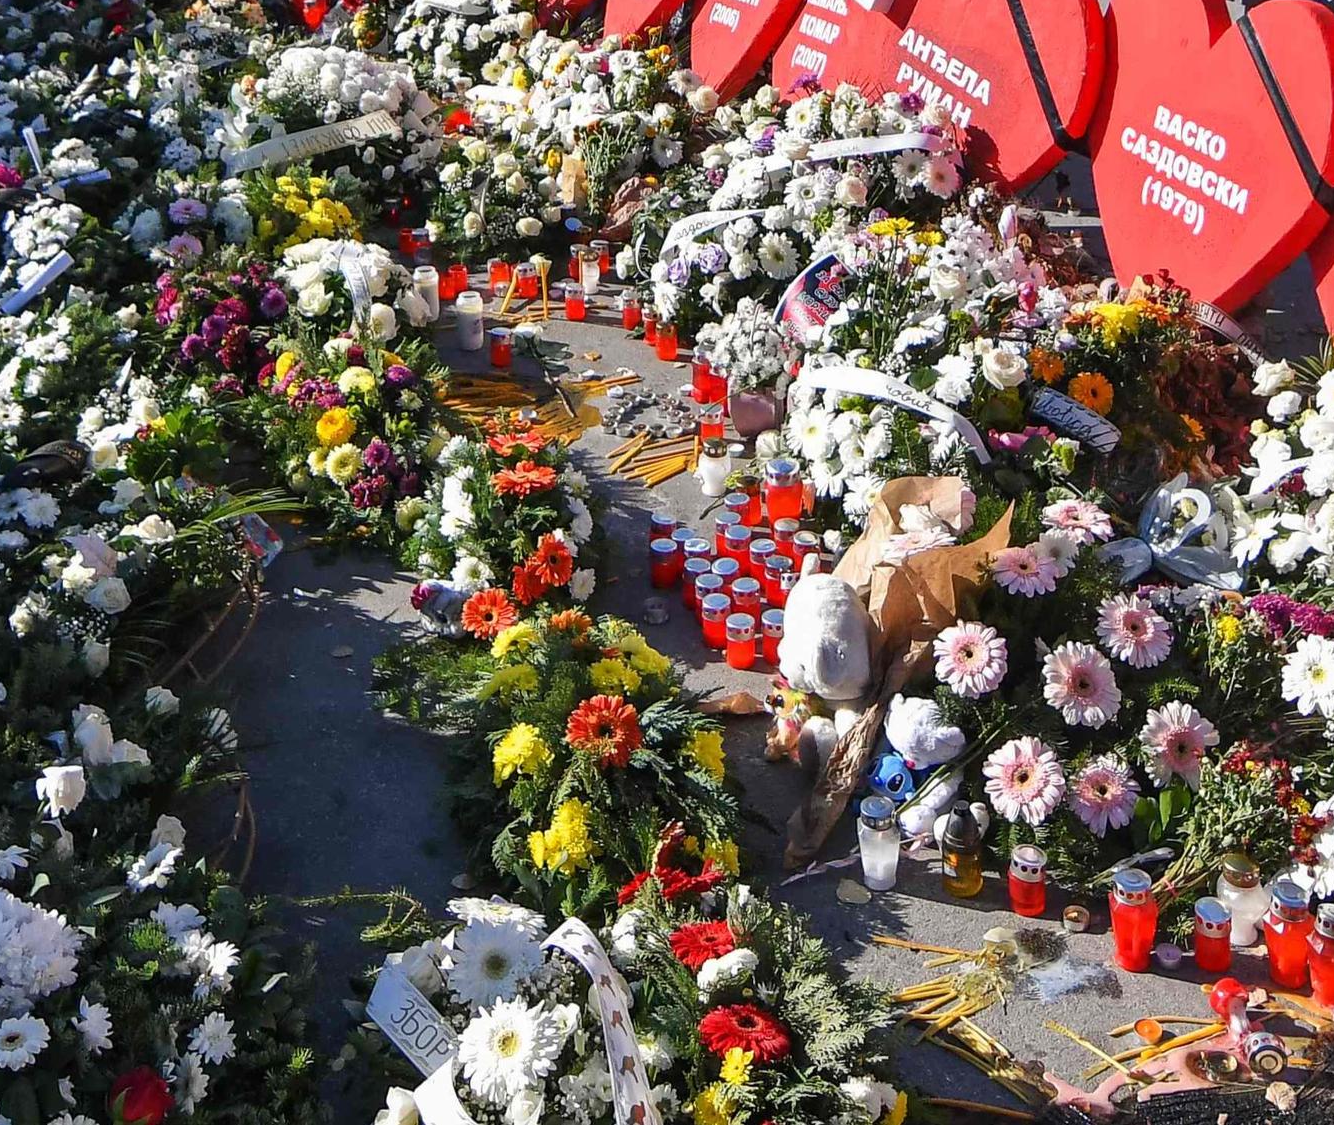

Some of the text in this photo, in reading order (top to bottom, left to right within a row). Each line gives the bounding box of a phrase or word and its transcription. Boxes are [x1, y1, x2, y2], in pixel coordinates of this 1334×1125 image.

[798, 13, 840, 44] КОМАР
[896, 62, 972, 129] РУМАН
[898, 28, 991, 106] АНЂЕЛА
[1153, 105, 1227, 161] ВАСКО
[1120, 127, 1249, 215] САЗДОВСКИ
[1141, 176, 1205, 235] (1979)
